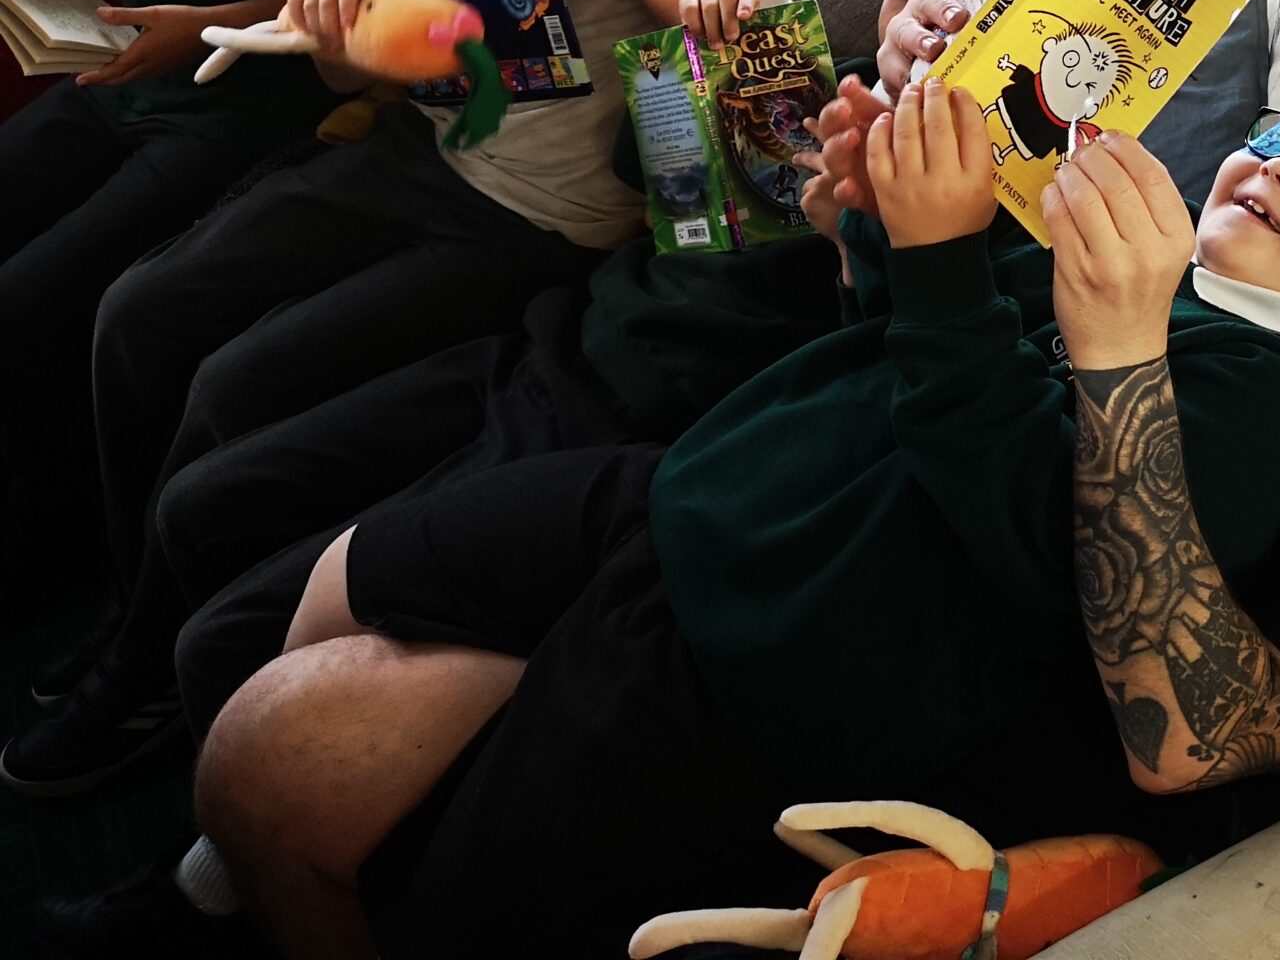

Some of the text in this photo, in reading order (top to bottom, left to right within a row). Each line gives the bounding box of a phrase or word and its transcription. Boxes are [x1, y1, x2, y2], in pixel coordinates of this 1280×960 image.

[717, 18, 809, 65] Beast
[1108, 4, 1137, 28] MEET
[1135, 25, 1163, 50] AGAIN
[731, 48, 819, 83] Quest
[1001, 181, 1029, 209] PASTIS
